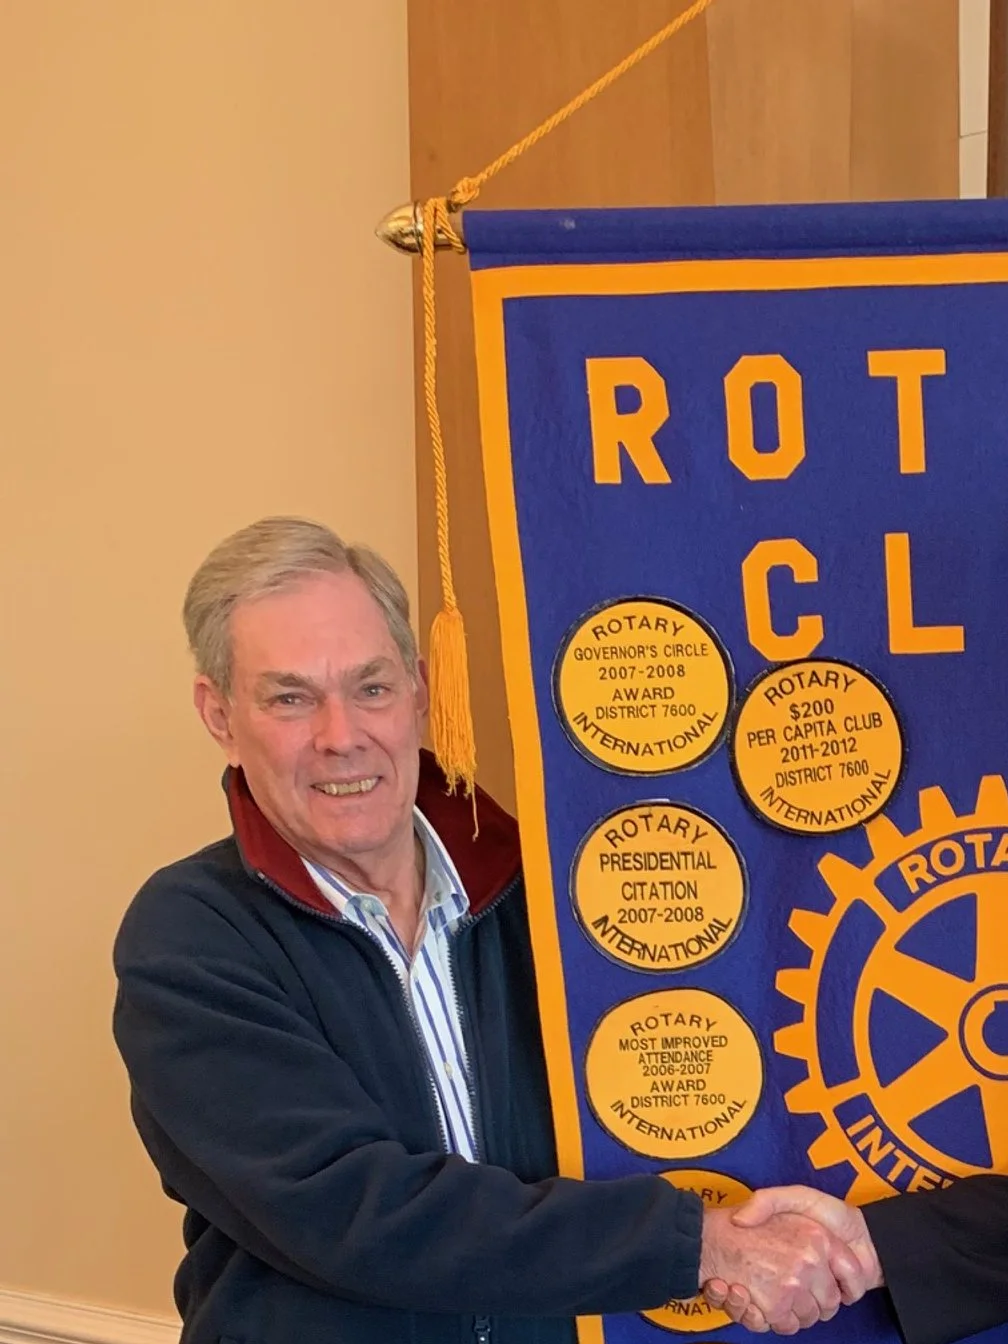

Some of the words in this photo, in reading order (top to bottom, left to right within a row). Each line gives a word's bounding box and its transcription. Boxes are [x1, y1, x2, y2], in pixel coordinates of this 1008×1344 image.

[592, 615, 685, 641] ROTARY
[574, 645, 658, 661] GOVERNOR'S
[664, 643, 709, 657] CIRCLE
[598, 666, 685, 680] 2007-2008
[612, 687, 675, 701] AWARD
[764, 670, 857, 706] ROTARY
[596, 706, 656, 720] DISTRICT
[662, 704, 696, 717] 7600
[789, 698, 834, 721] $200
[572, 711, 718, 757] INTERNATIONAL
[747, 729, 777, 748] PER
[783, 720, 837, 742] CAPITA
[844, 712, 883, 732] CLUB
[780, 738, 858, 763] 2011-2012
[775, 765, 833, 788] DISTRICT
[839, 760, 869, 779] 7600
[760, 769, 892, 826] INTERNATIONAL
[605, 814, 708, 848] ROTARY
[599, 851, 717, 872] PRESIDENTIAL
[621, 880, 698, 901] CITATION
[617, 907, 704, 924] 2007-2008
[591, 914, 732, 962] INTERNATIONAL
[630, 1012, 718, 1036] ROTARY
[618, 1037, 657, 1052] MOST
[661, 1035, 728, 1050] IMPROVED
[638, 1051, 713, 1065] ATTENDANCE
[642, 1063, 711, 1077] 2006-2007
[650, 1079, 706, 1093] AWARD
[630, 1094, 689, 1108] DISTRICT
[694, 1093, 726, 1105] 7600
[610, 1097, 748, 1142] INTERNATIONAL
